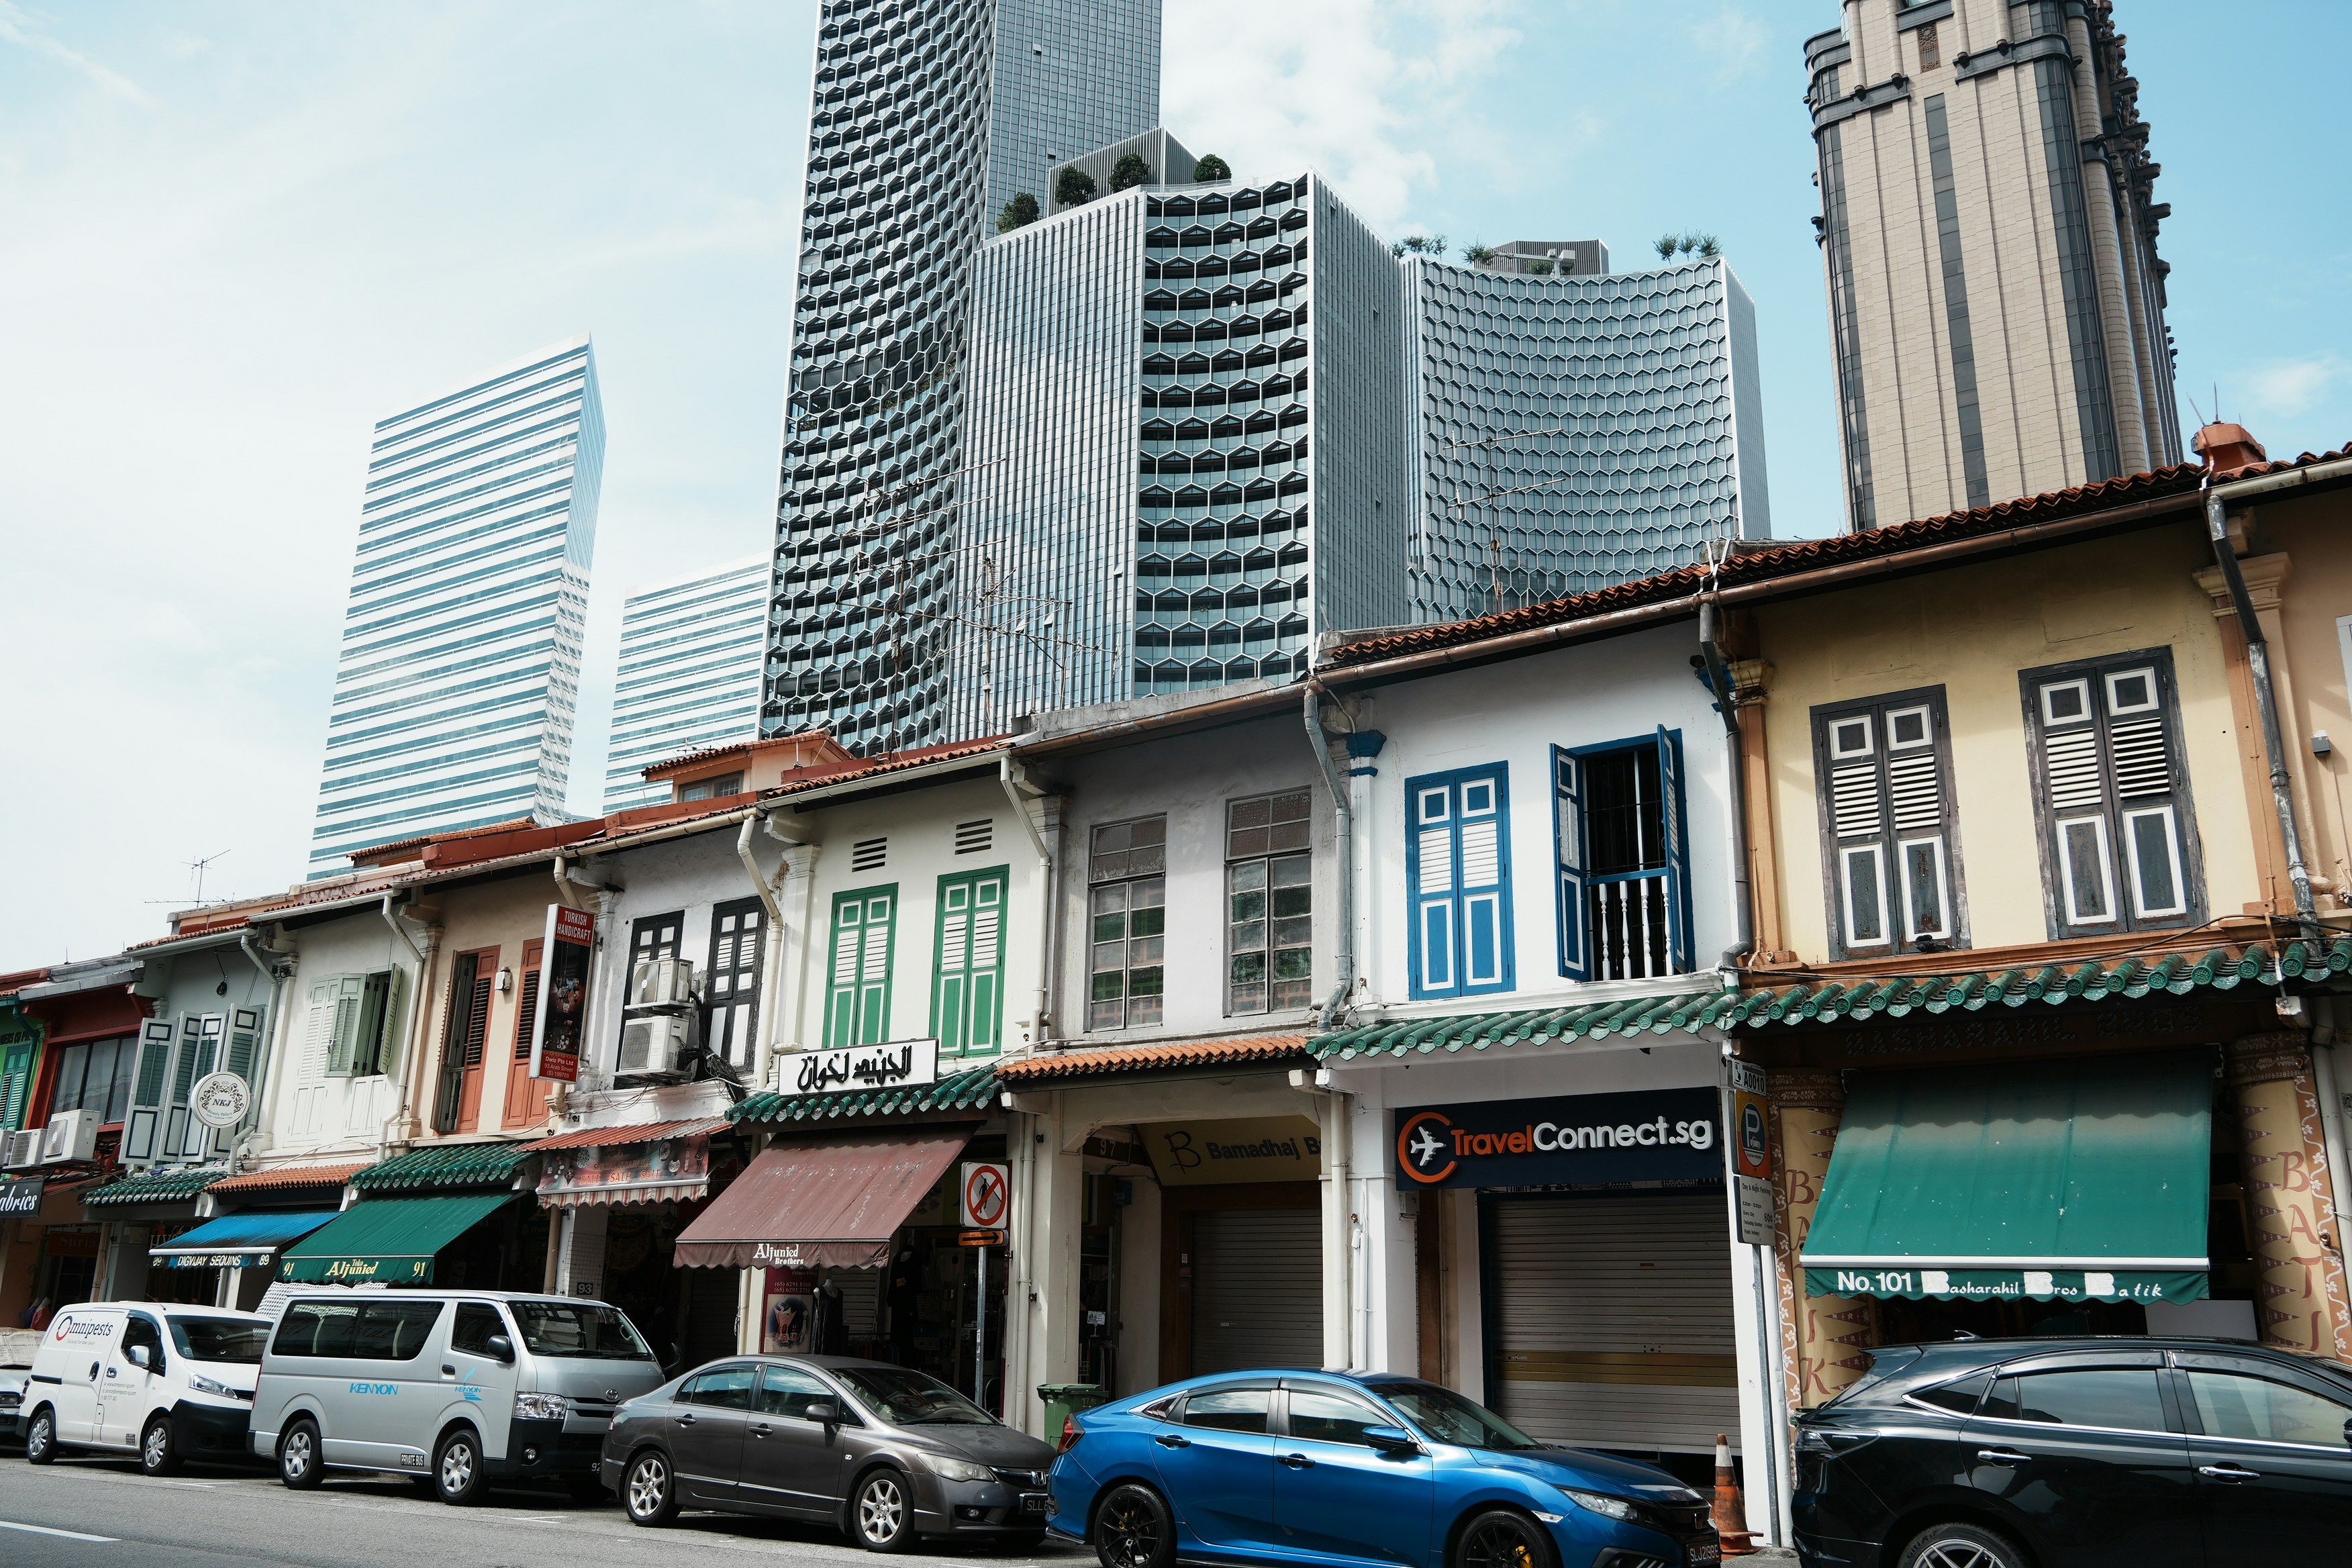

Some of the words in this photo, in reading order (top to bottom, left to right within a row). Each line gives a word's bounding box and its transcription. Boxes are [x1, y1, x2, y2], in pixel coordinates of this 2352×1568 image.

[564, 910, 588, 926] TURKISH
[556, 923, 591, 941] HANDICRAFT
[550, 1063, 560, 1071] Arab
[1743, 1071, 1765, 1093] A0010
[212, 1099, 232, 1107] NKJ
[1450, 1115, 1714, 1157] TravelConnect.sg
[1745, 1108, 1760, 1148] P
[1100, 1138, 1116, 1157] 97
[1206, 1137, 1302, 1161] Bamadhaj
[1304, 1136, 1321, 1155] B
[593, 1161, 618, 1171] SPECIAL
[618, 1159, 652, 1169] CLEARANCE
[579, 1175, 601, 1185] SALE
[609, 1171, 631, 1183] SALE
[639, 1169, 661, 1181] SALE
[0, 1185, 37, 1212] abrics
[1759, 1187, 1771, 1195] Parking
[60, 1234, 96, 1248] Suria
[152, 1257, 162, 1267] 89
[177, 1255, 207, 1267] DIGVIJAY
[209, 1255, 242, 1266] SEQUINS
[258, 1254, 270, 1266] 89
[752, 1243, 799, 1262] Aljunied
[352, 1259, 364, 1267] Toko
[775, 1257, 804, 1265] Brothers
[283, 1262, 295, 1276] 91
[325, 1261, 379, 1279] Aljunied
[412, 1261, 426, 1277] 91
[578, 1283, 593, 1294] 93
[1921, 1271, 2020, 1295] Basharahil
[2023, 1271, 2078, 1295] Bros
[2084, 1271, 2163, 1297] Batik
[56, 1315, 113, 1341] Omnipests
[349, 1383, 399, 1395] KENYON
[454, 1385, 482, 1393] KENYON
[401, 1454, 415, 1466] PRIVATE
[415, 1455, 424, 1466] BUS
